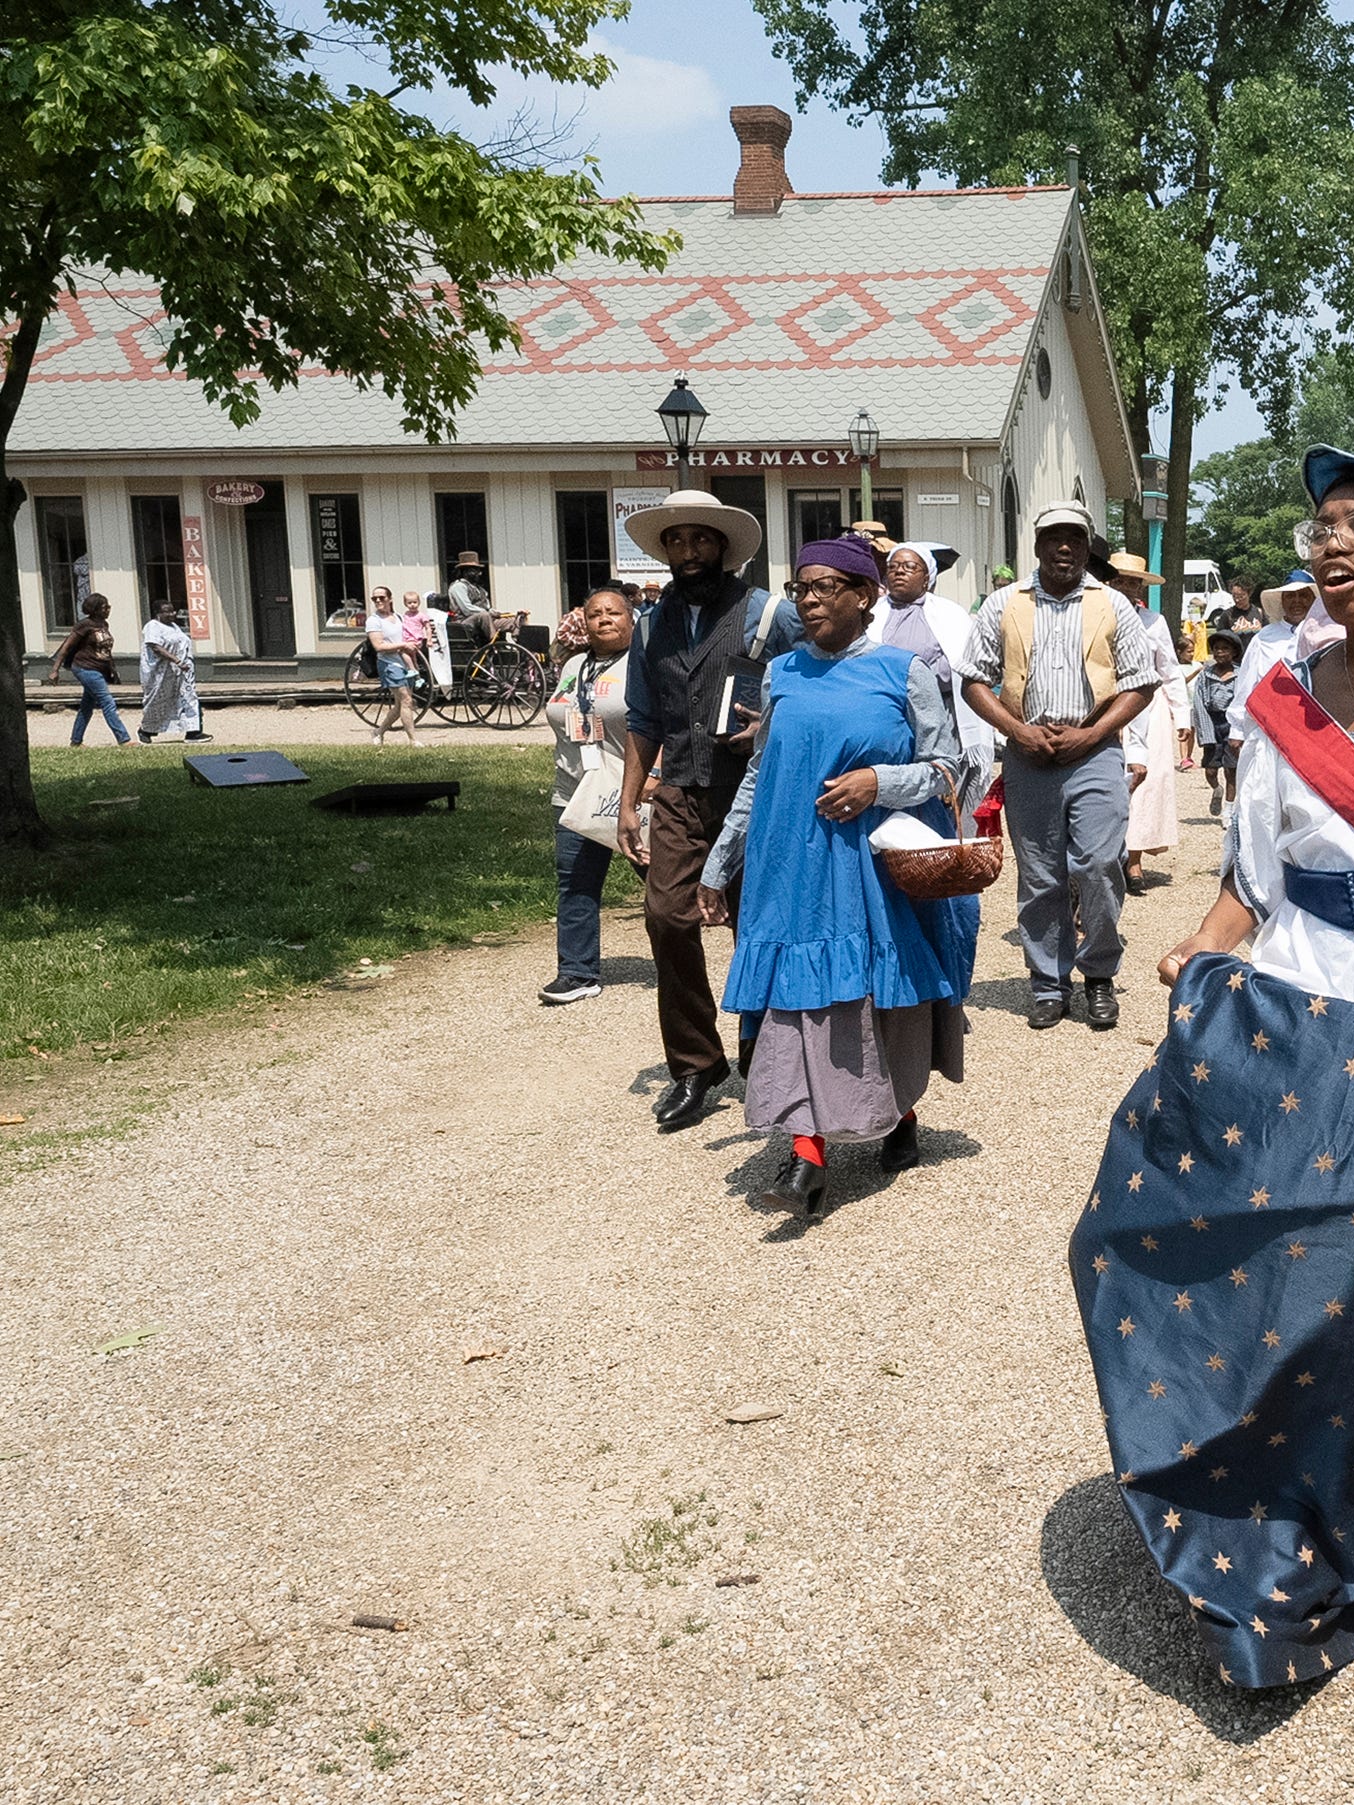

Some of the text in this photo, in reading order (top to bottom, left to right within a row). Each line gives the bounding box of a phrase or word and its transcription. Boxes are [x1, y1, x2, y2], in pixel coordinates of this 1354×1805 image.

[665, 450, 851, 467] PHARMACY
[215, 482, 255, 494] BAKERY
[215, 494, 257, 503] CONFECTIONS
[323, 537, 338, 551] &
[184, 527, 207, 630] BAKERY
[429, 619, 444, 654] UNITY
